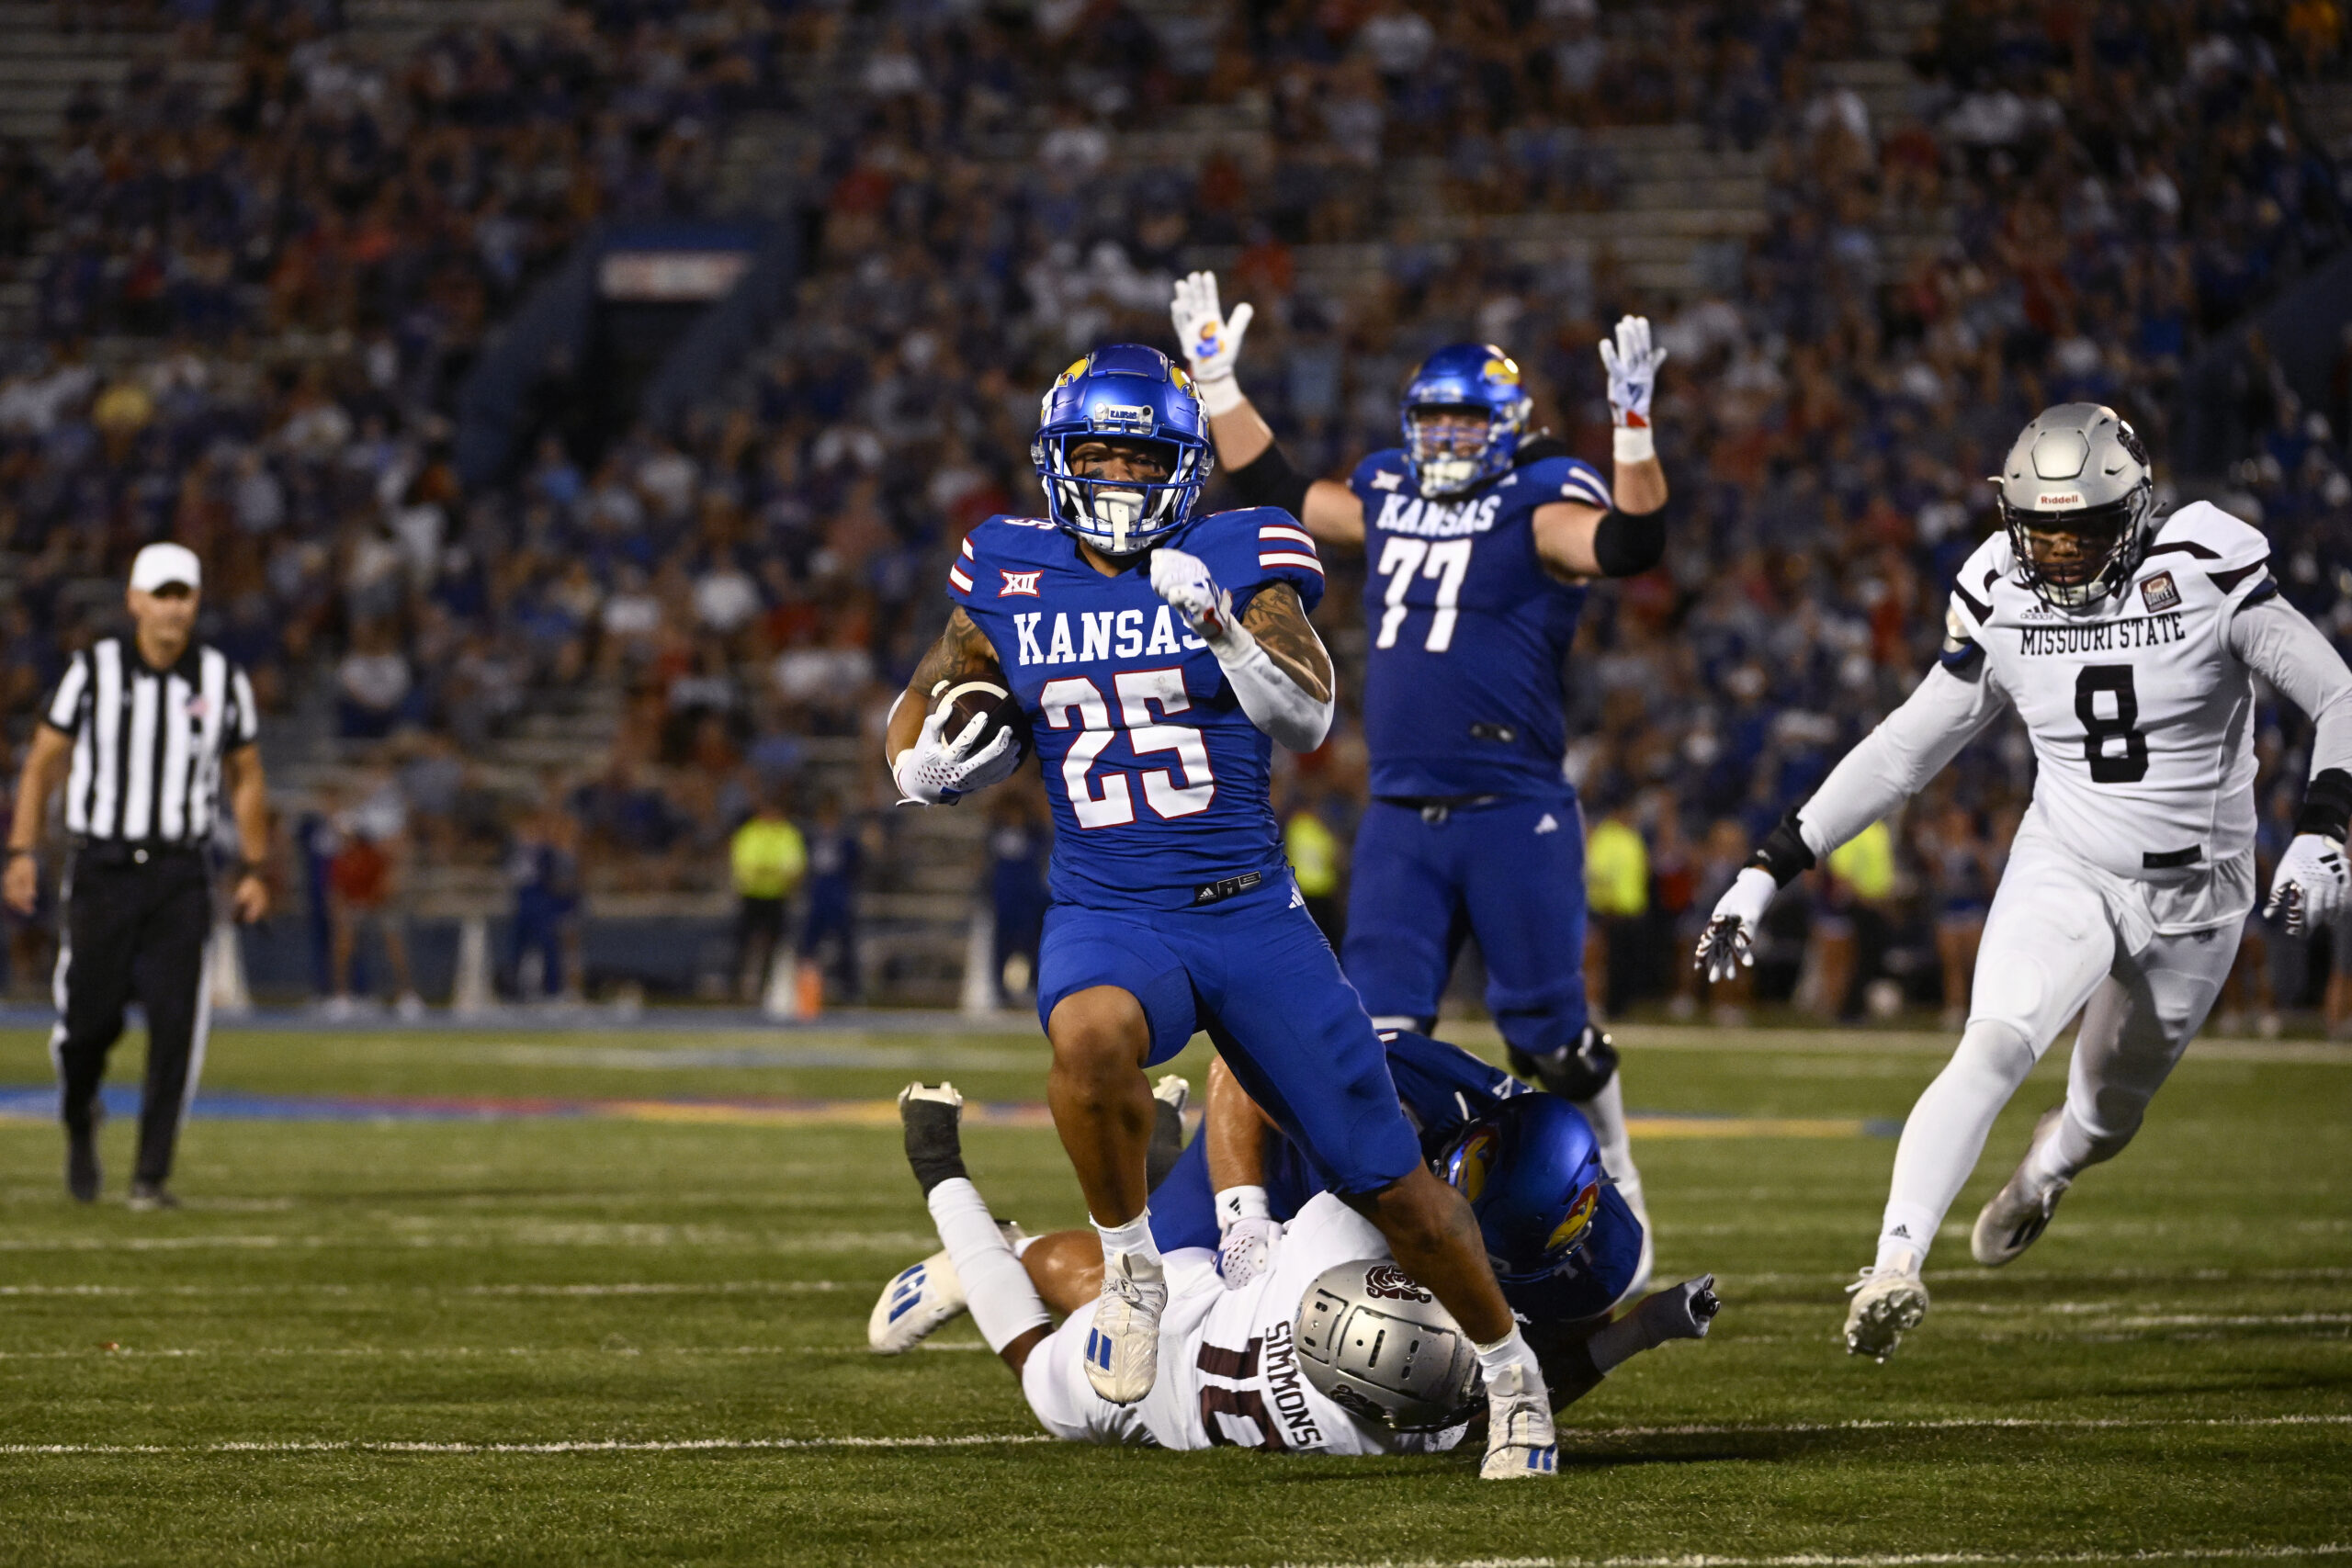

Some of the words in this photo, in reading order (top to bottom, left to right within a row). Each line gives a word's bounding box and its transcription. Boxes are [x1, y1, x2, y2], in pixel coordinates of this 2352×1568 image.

[1376, 493, 1501, 536] KANSAS
[2041, 494, 2078, 504] Riddell
[1376, 536, 1473, 652] 77
[2020, 624, 2112, 656] MISSOURI
[2120, 612, 2186, 648] STATE
[1039, 665, 1216, 829] 25
[2075, 664, 2149, 784] 8
[1266, 1320, 1323, 1446] SIMMONS
